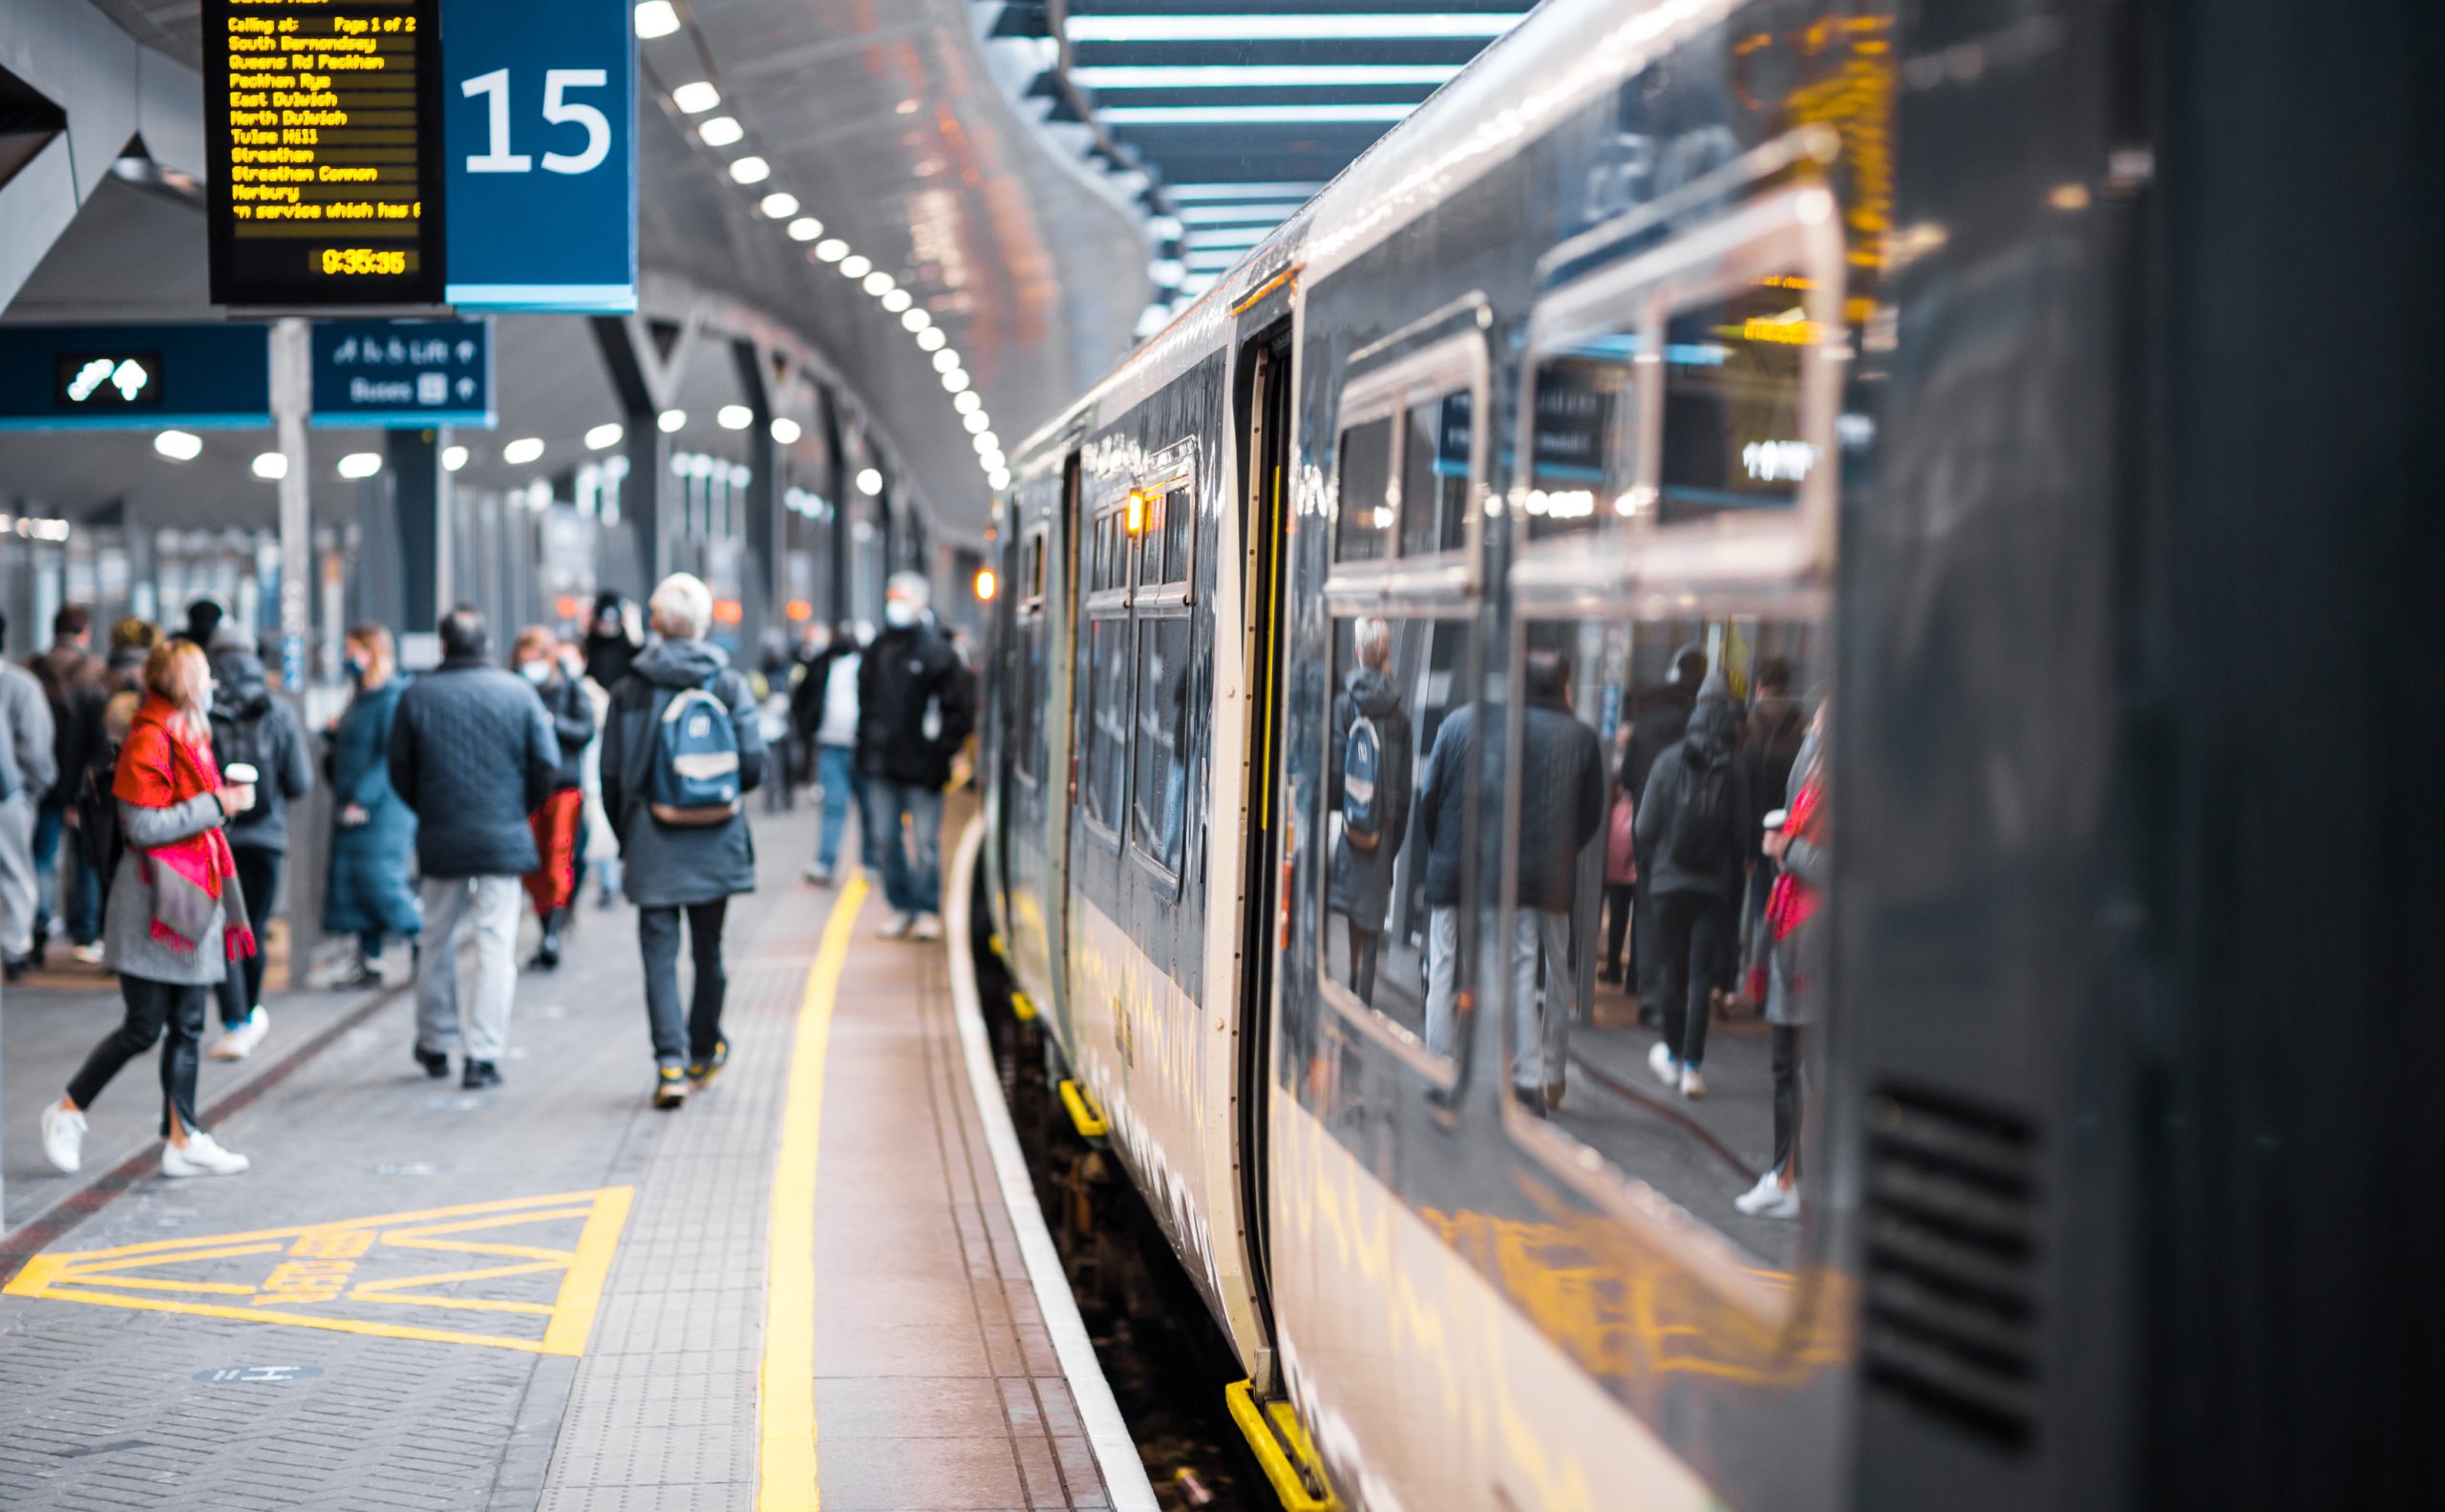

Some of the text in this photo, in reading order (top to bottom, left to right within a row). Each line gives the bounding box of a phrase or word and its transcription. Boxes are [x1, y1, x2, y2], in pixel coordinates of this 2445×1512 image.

[228, 17, 274, 34] Calling
[334, 17, 368, 34] Page
[372, 17, 380, 32] 1
[384, 17, 402, 32] of
[405, 17, 415, 32] 2
[229, 36, 276, 51] South
[229, 55, 287, 70] Queens
[292, 54, 313, 69] Rd
[300, 74, 330, 91] Rye
[230, 92, 337, 107] East Dulwich
[230, 110, 347, 125] North Dulwich
[461, 68, 611, 175] 15
[231, 129, 318, 144] Tulse Hill
[233, 184, 300, 203] Norbury
[256, 202, 321, 219] service
[326, 202, 373, 218] which
[378, 202, 409, 218] has
[351, 376, 414, 403] Buses
